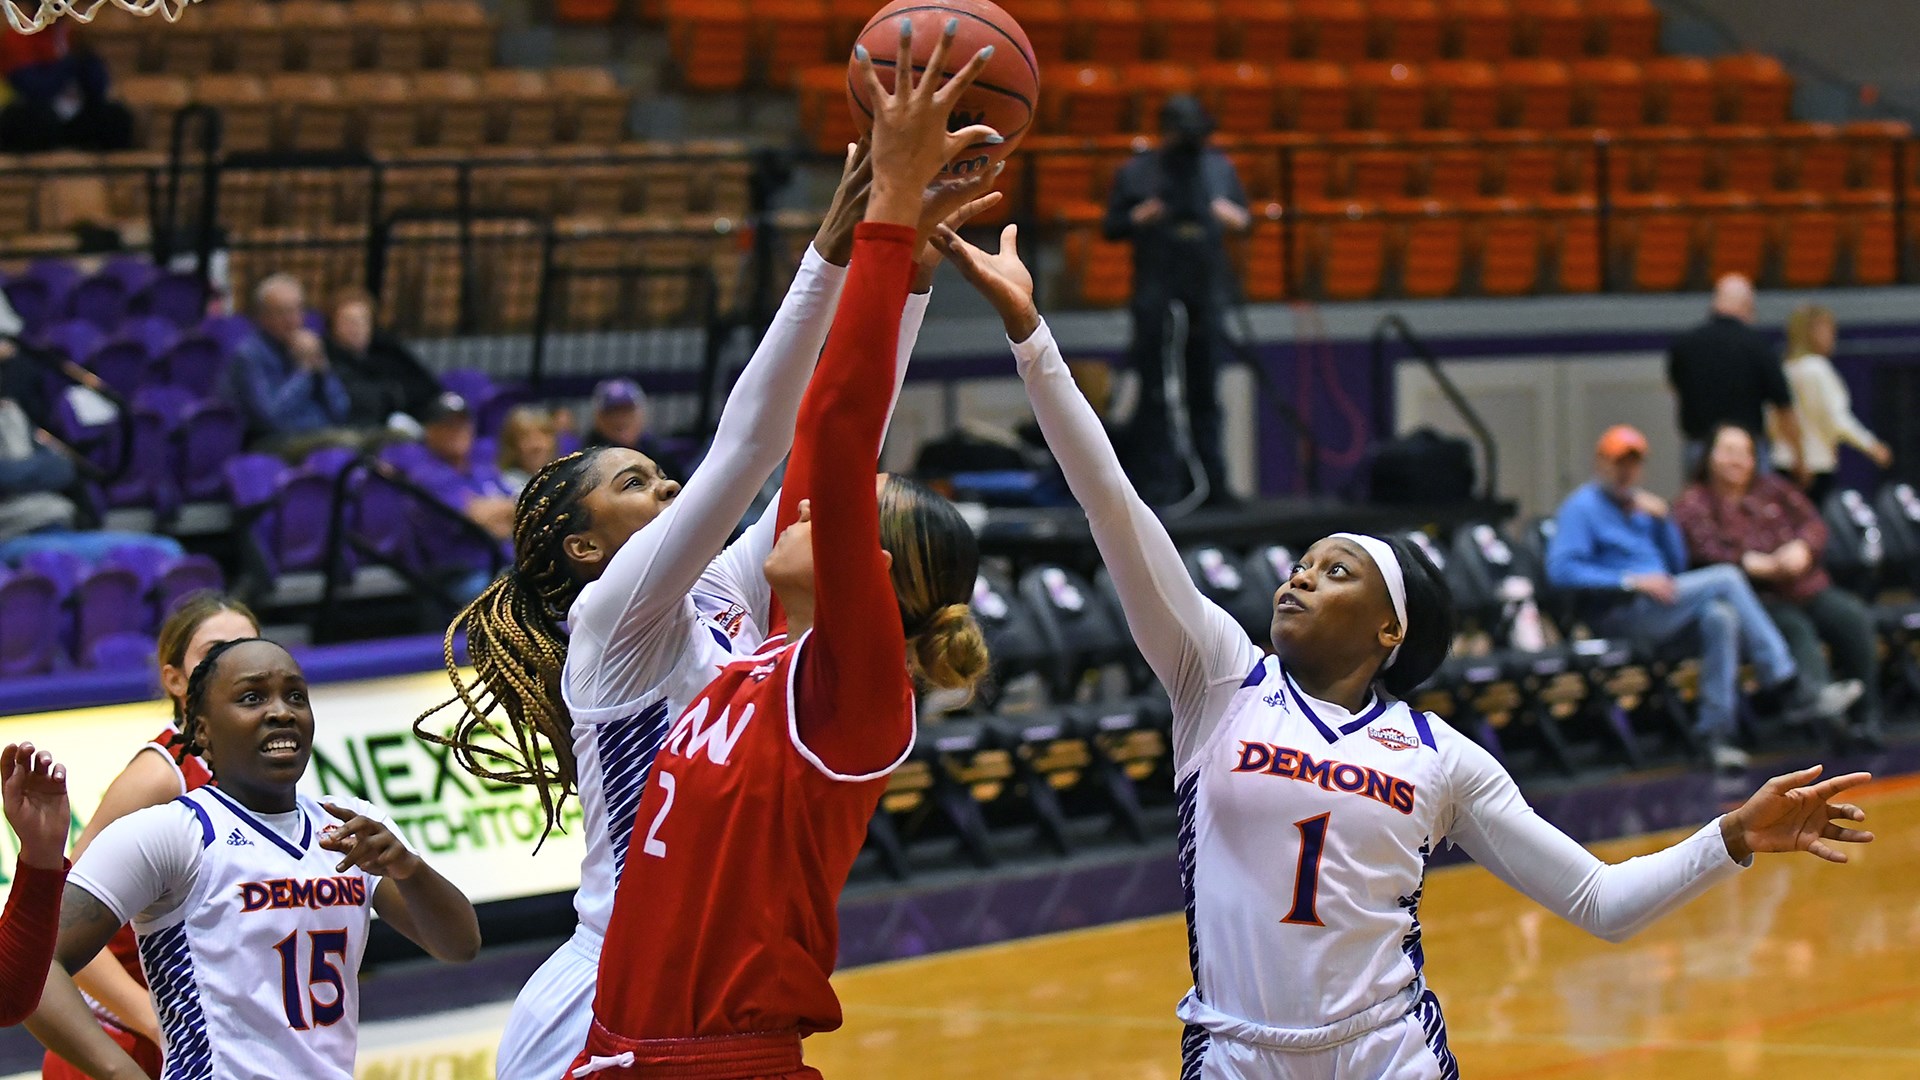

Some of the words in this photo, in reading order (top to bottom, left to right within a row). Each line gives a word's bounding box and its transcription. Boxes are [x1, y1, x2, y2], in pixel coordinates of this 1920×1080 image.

[642, 770, 676, 859] 2
[1230, 740, 1416, 815] DEMONS
[238, 875, 366, 913] DEMONS
[1279, 811, 1331, 927] 1
[273, 927, 349, 1031] 15
